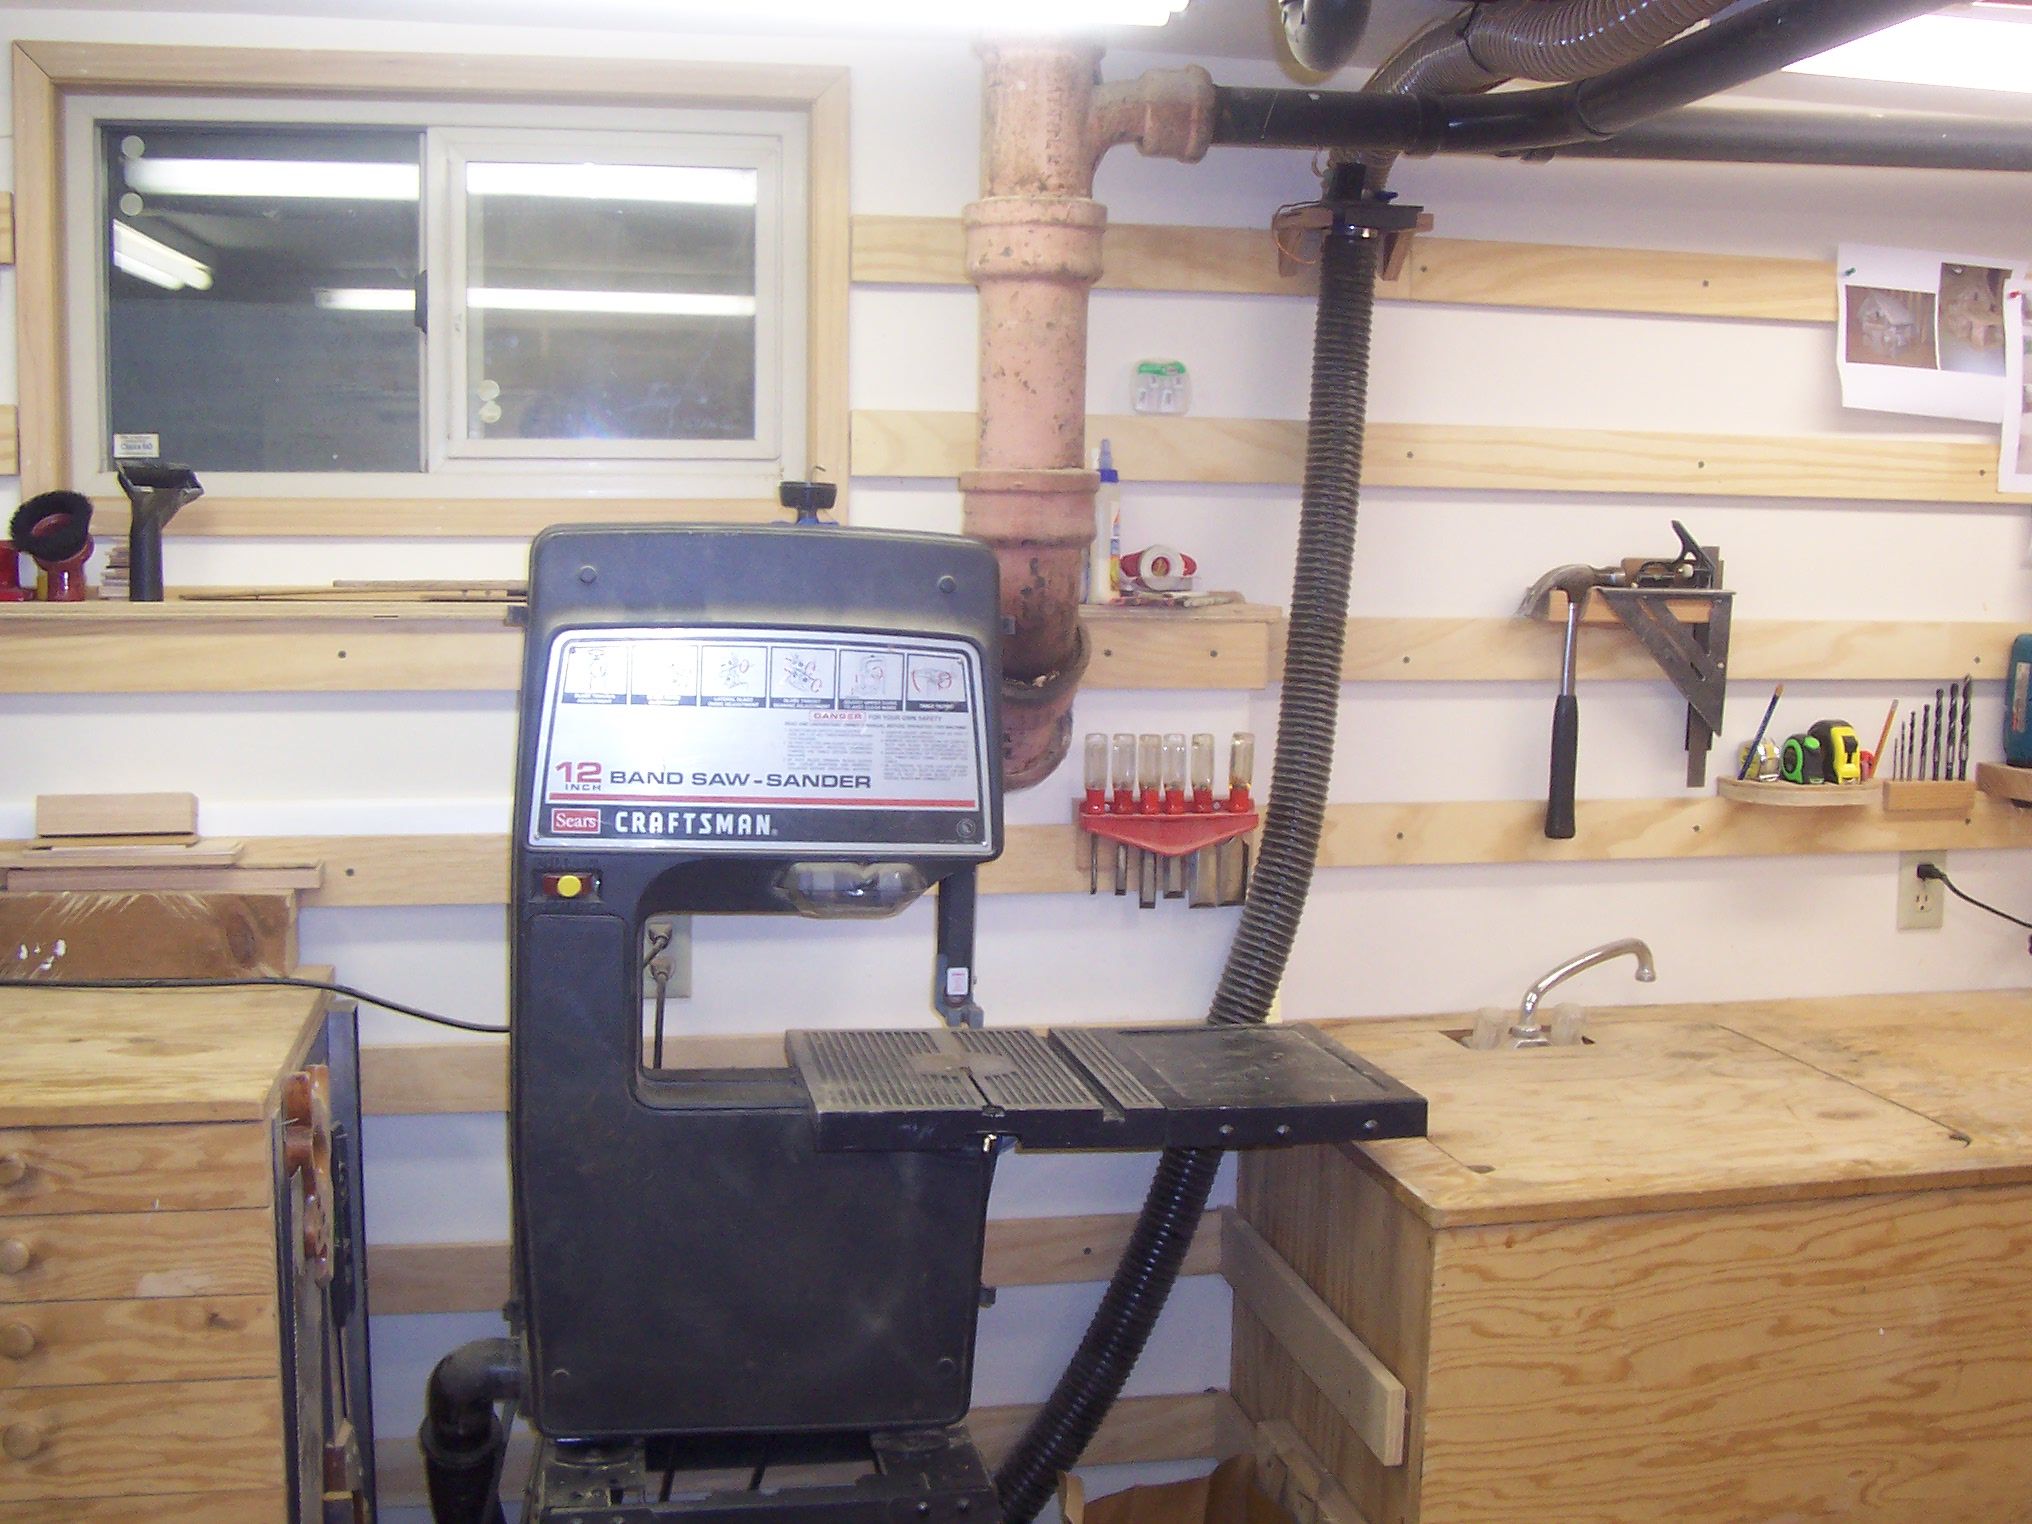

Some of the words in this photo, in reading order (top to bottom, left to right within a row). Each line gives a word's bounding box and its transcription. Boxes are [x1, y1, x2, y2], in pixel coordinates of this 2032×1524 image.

[813, 712, 863, 721] DANGER
[868, 713, 882, 721] FOR
[555, 761, 602, 783] 12
[610, 770, 684, 785] BAND
[565, 784, 602, 792] INCH
[555, 812, 597, 829] Sears
[614, 810, 772, 837] CRAFTSMAN
